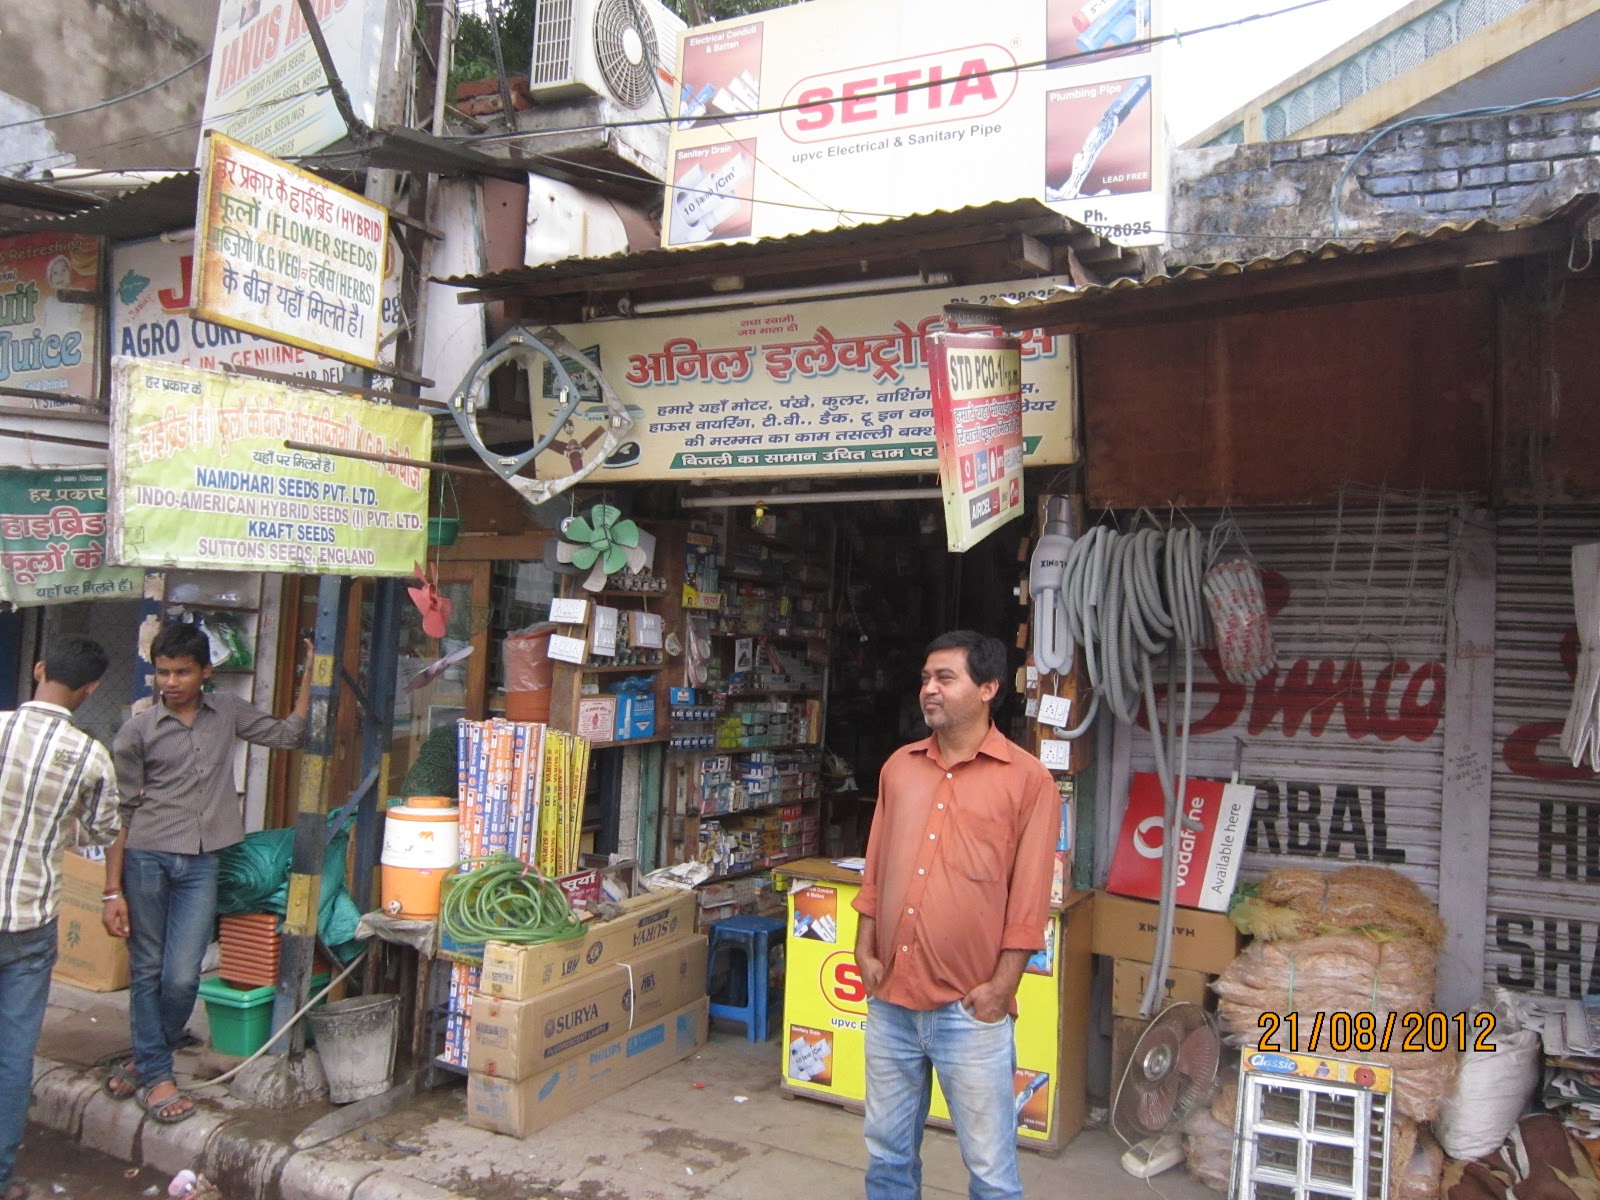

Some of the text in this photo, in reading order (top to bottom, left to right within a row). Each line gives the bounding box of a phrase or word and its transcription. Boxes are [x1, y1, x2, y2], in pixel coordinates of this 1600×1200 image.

[690, 25, 757, 47] Electrical Conduit
[713, 40, 739, 53] Batten
[796, 58, 998, 131] SETIA
[1050, 84, 1122, 103] Plumbing Pipe
[678, 144, 732, 160] Sanitary Drain
[792, 123, 1002, 163] upvc Electrical & Sanitary Pipe
[1102, 171, 1148, 184] LEAD FREE
[1084, 208, 1108, 223] Ph.
[121, 319, 180, 358] AGRO
[625, 337, 753, 385] अनिल
[950, 354, 973, 392] STD
[768, 433, 790, 445] का
[794, 431, 829, 443] काम
[682, 453, 733, 467] बिजली
[737, 454, 760, 466] का
[871, 448, 904, 460] दाम
[910, 446, 934, 459] पर
[196, 467, 378, 507] NAMDHARI SEEDS PVT. LTD.
[137, 486, 256, 516] INDO-AMERICAN
[259, 498, 311, 521] HYBRID
[312, 503, 349, 523] SEEDS
[367, 511, 393, 529] PVT.
[396, 513, 424, 530] LTD.
[972, 498, 992, 521] AIRCEL
[248, 520, 336, 543] KRAFT SEEDS
[71, 540, 104, 570] के
[198, 538, 375, 566] SUTTONS SEEDS, ENGLAND
[1175, 797, 1205, 888] vodafne
[1211, 802, 1241, 895] Available here
[633, 921, 669, 947] SURYA
[556, 1003, 598, 1033] SURYA
[831, 1017, 857, 1029] upvc
[1251, 1054, 1296, 1070] Classic
